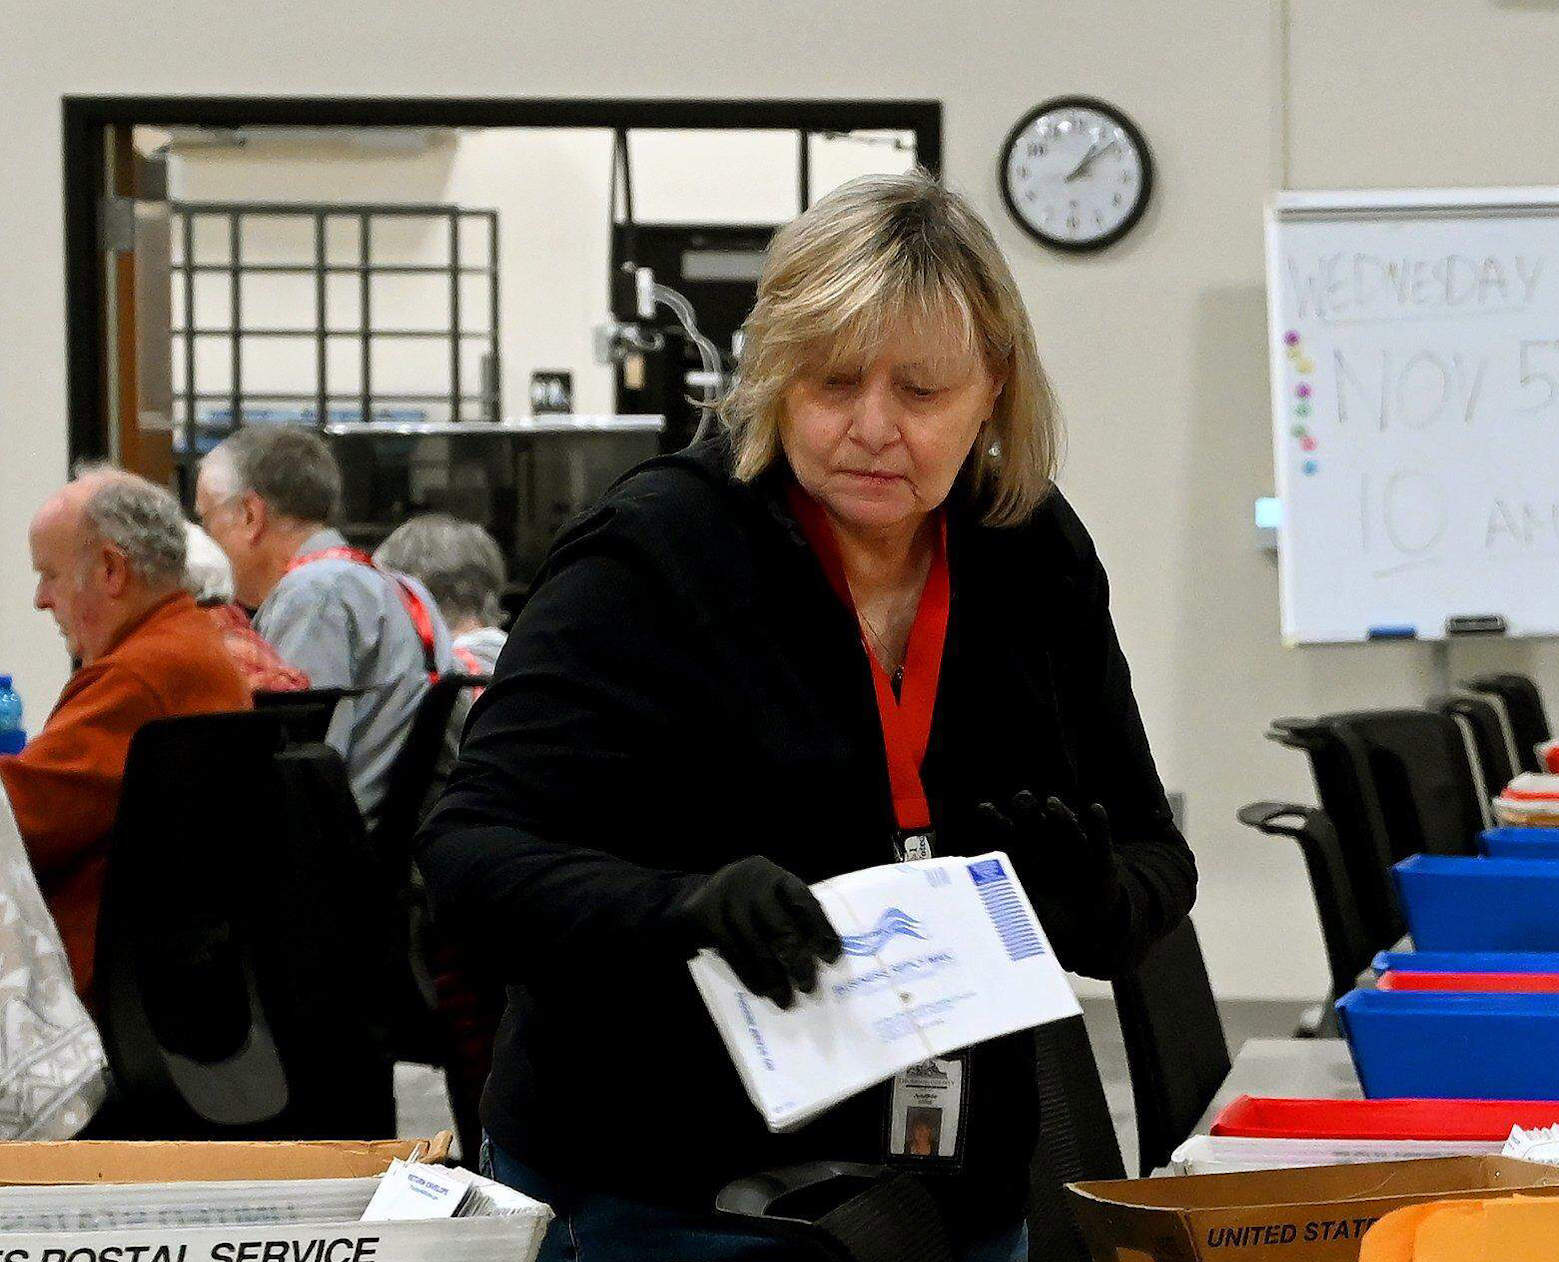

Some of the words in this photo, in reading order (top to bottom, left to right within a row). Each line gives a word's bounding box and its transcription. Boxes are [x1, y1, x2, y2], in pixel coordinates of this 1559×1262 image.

[1334, 349, 1488, 432] NOV
[1357, 467, 1448, 555] 10
[1207, 1224, 1297, 1248] UNITED
[1303, 1218, 1377, 1242] STAT
